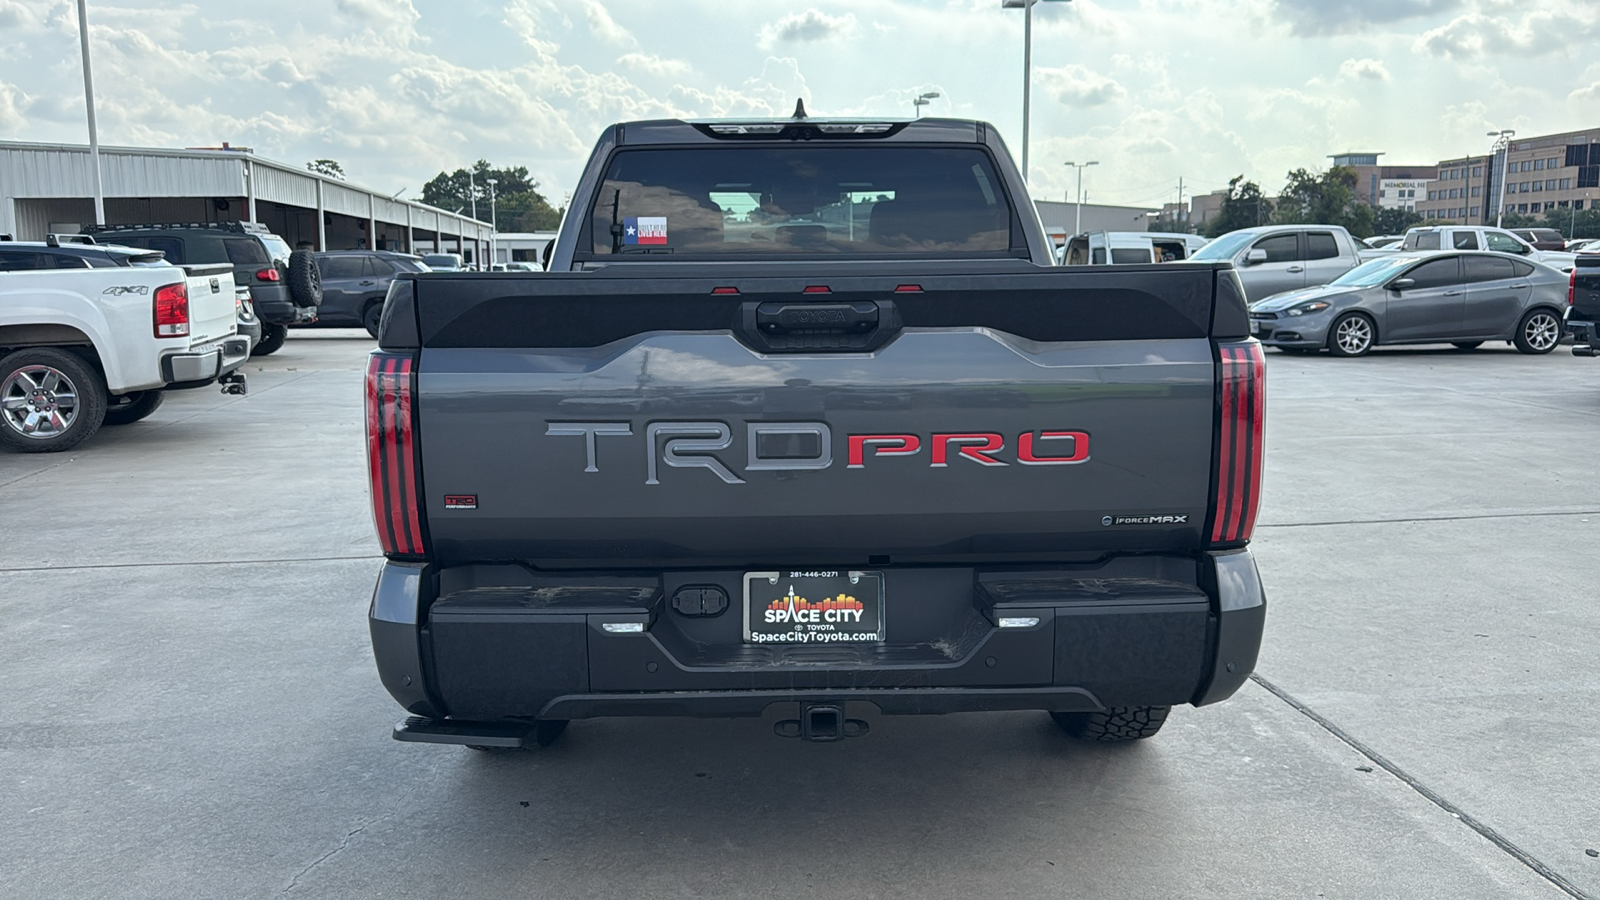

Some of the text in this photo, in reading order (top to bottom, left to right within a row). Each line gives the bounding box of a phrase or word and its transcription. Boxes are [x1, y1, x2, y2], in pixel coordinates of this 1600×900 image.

[790, 310, 846, 322] TOYOTA
[545, 419, 1092, 485] TRD PRO
[1149, 515, 1187, 523] MAX
[764, 608, 864, 623] SPACE CITY
[751, 631, 877, 643] SpaceCityToyota.com
